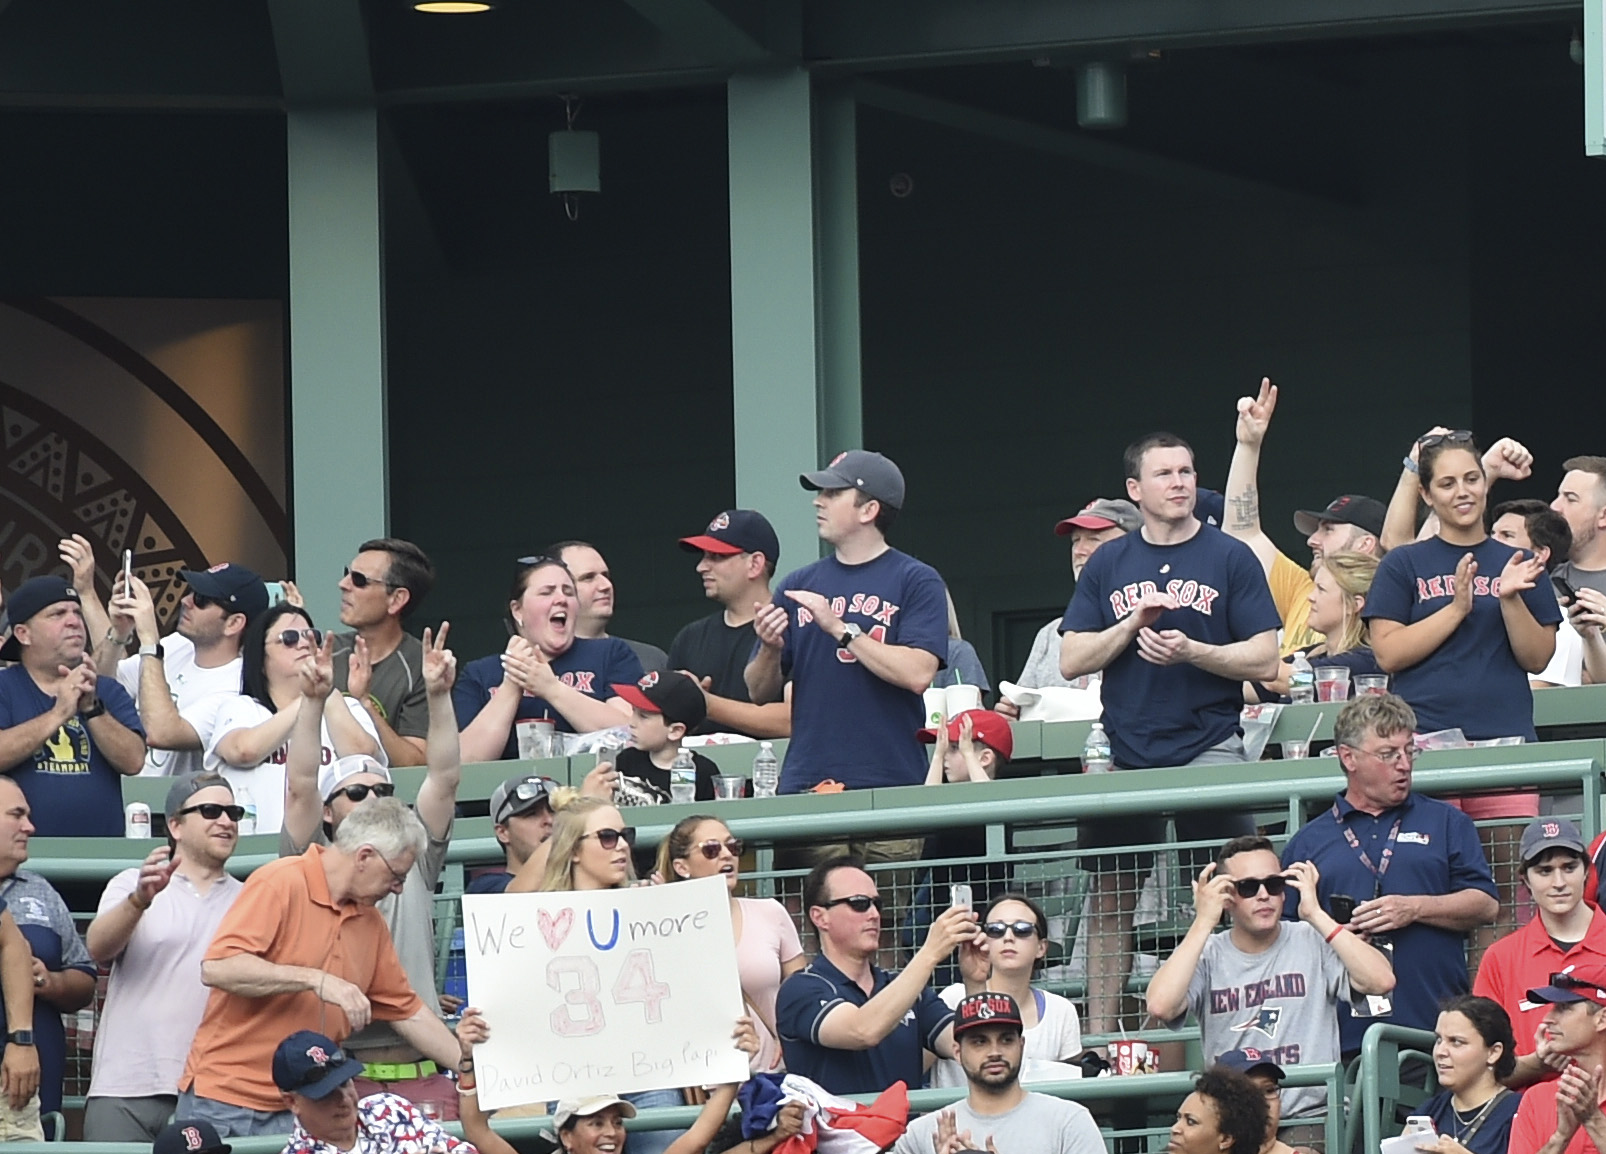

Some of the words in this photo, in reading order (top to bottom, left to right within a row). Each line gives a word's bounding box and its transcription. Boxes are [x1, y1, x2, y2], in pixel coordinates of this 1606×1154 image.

[1166, 579, 1219, 616] SOX
[1473, 575, 1502, 598] SO
[797, 595, 846, 628] RD
[849, 592, 900, 627] SOX
[472, 912, 525, 955] We
[586, 908, 620, 951] U
[628, 909, 709, 942] more
[546, 948, 671, 1038] 34
[480, 1064, 544, 1097] David
[552, 1061, 617, 1085] Ortiz
[632, 1050, 674, 1078] Big
[681, 1041, 718, 1066] Papi
[181, 1126, 203, 1150] B
